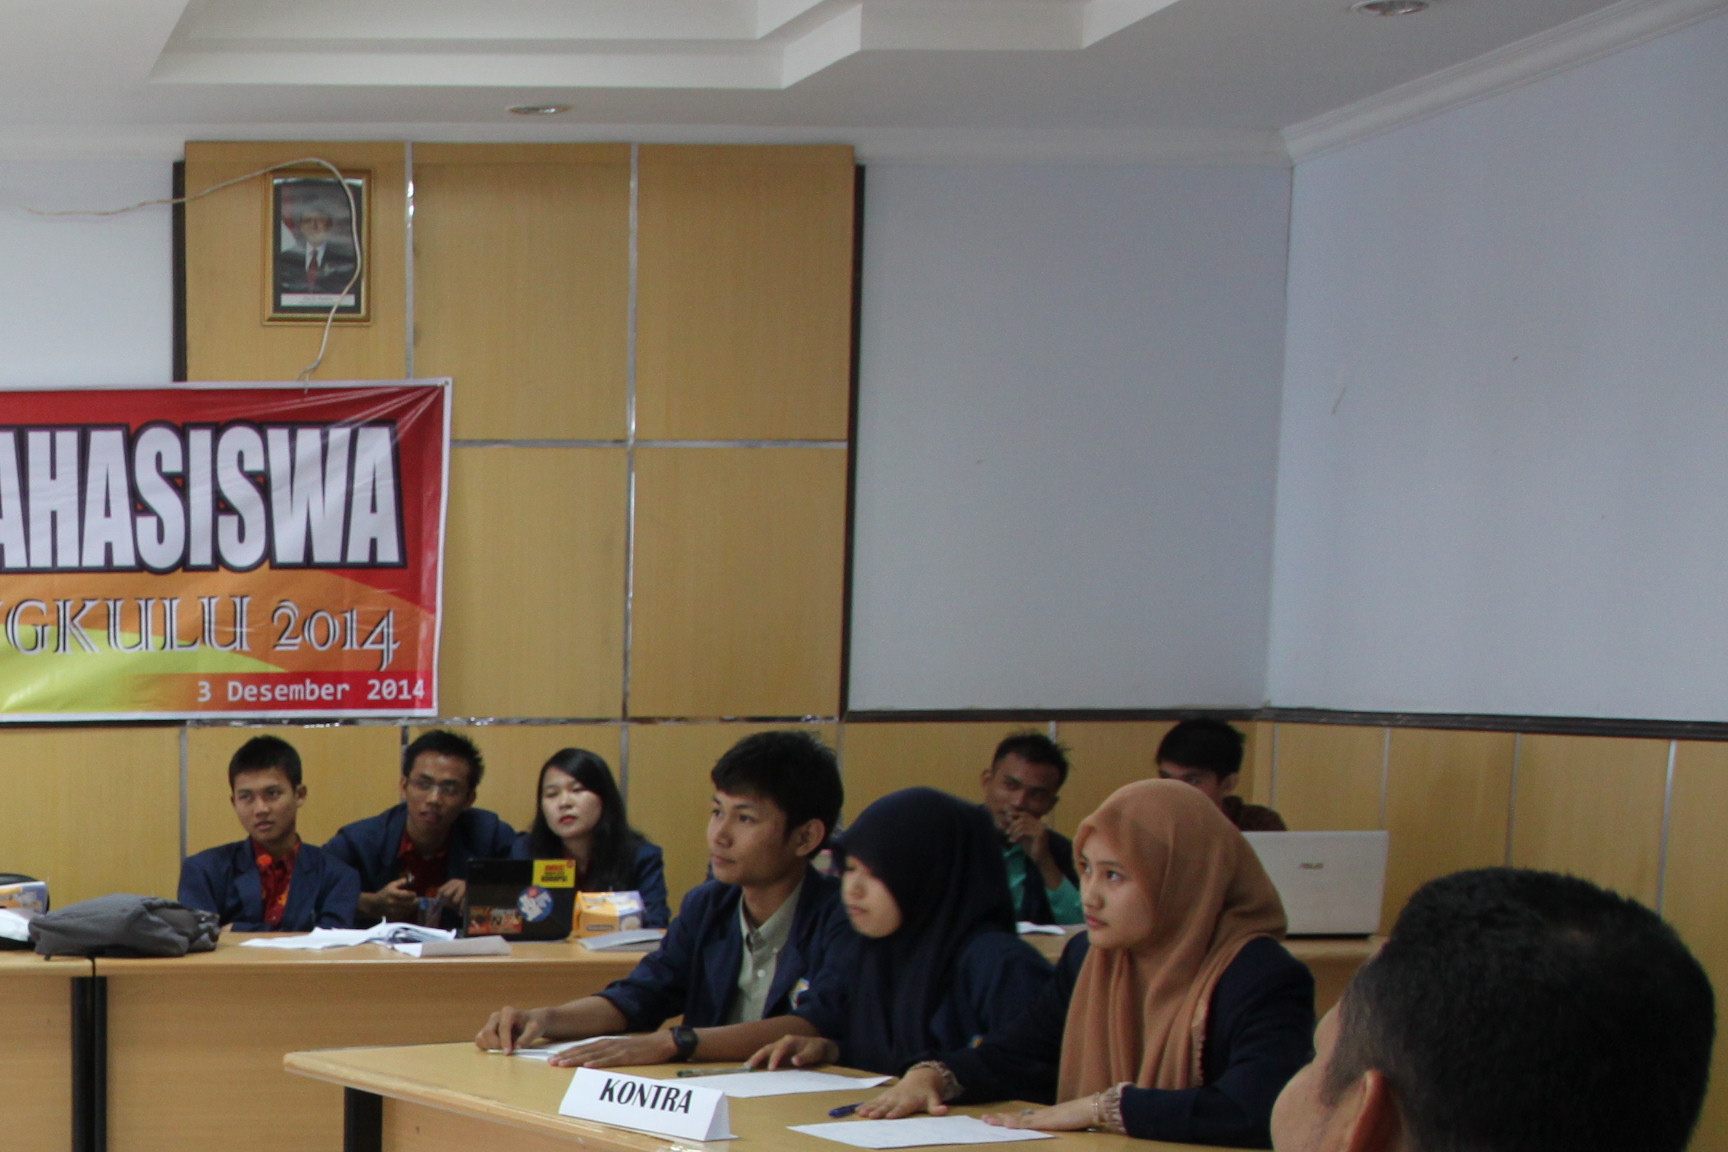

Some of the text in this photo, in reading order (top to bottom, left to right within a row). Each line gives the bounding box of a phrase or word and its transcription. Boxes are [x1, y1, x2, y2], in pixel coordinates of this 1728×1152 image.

[272, 599, 401, 672] 2014
[197, 678, 426, 702] 3 Desember 2014
[599, 1077, 694, 1114] KONTRA
